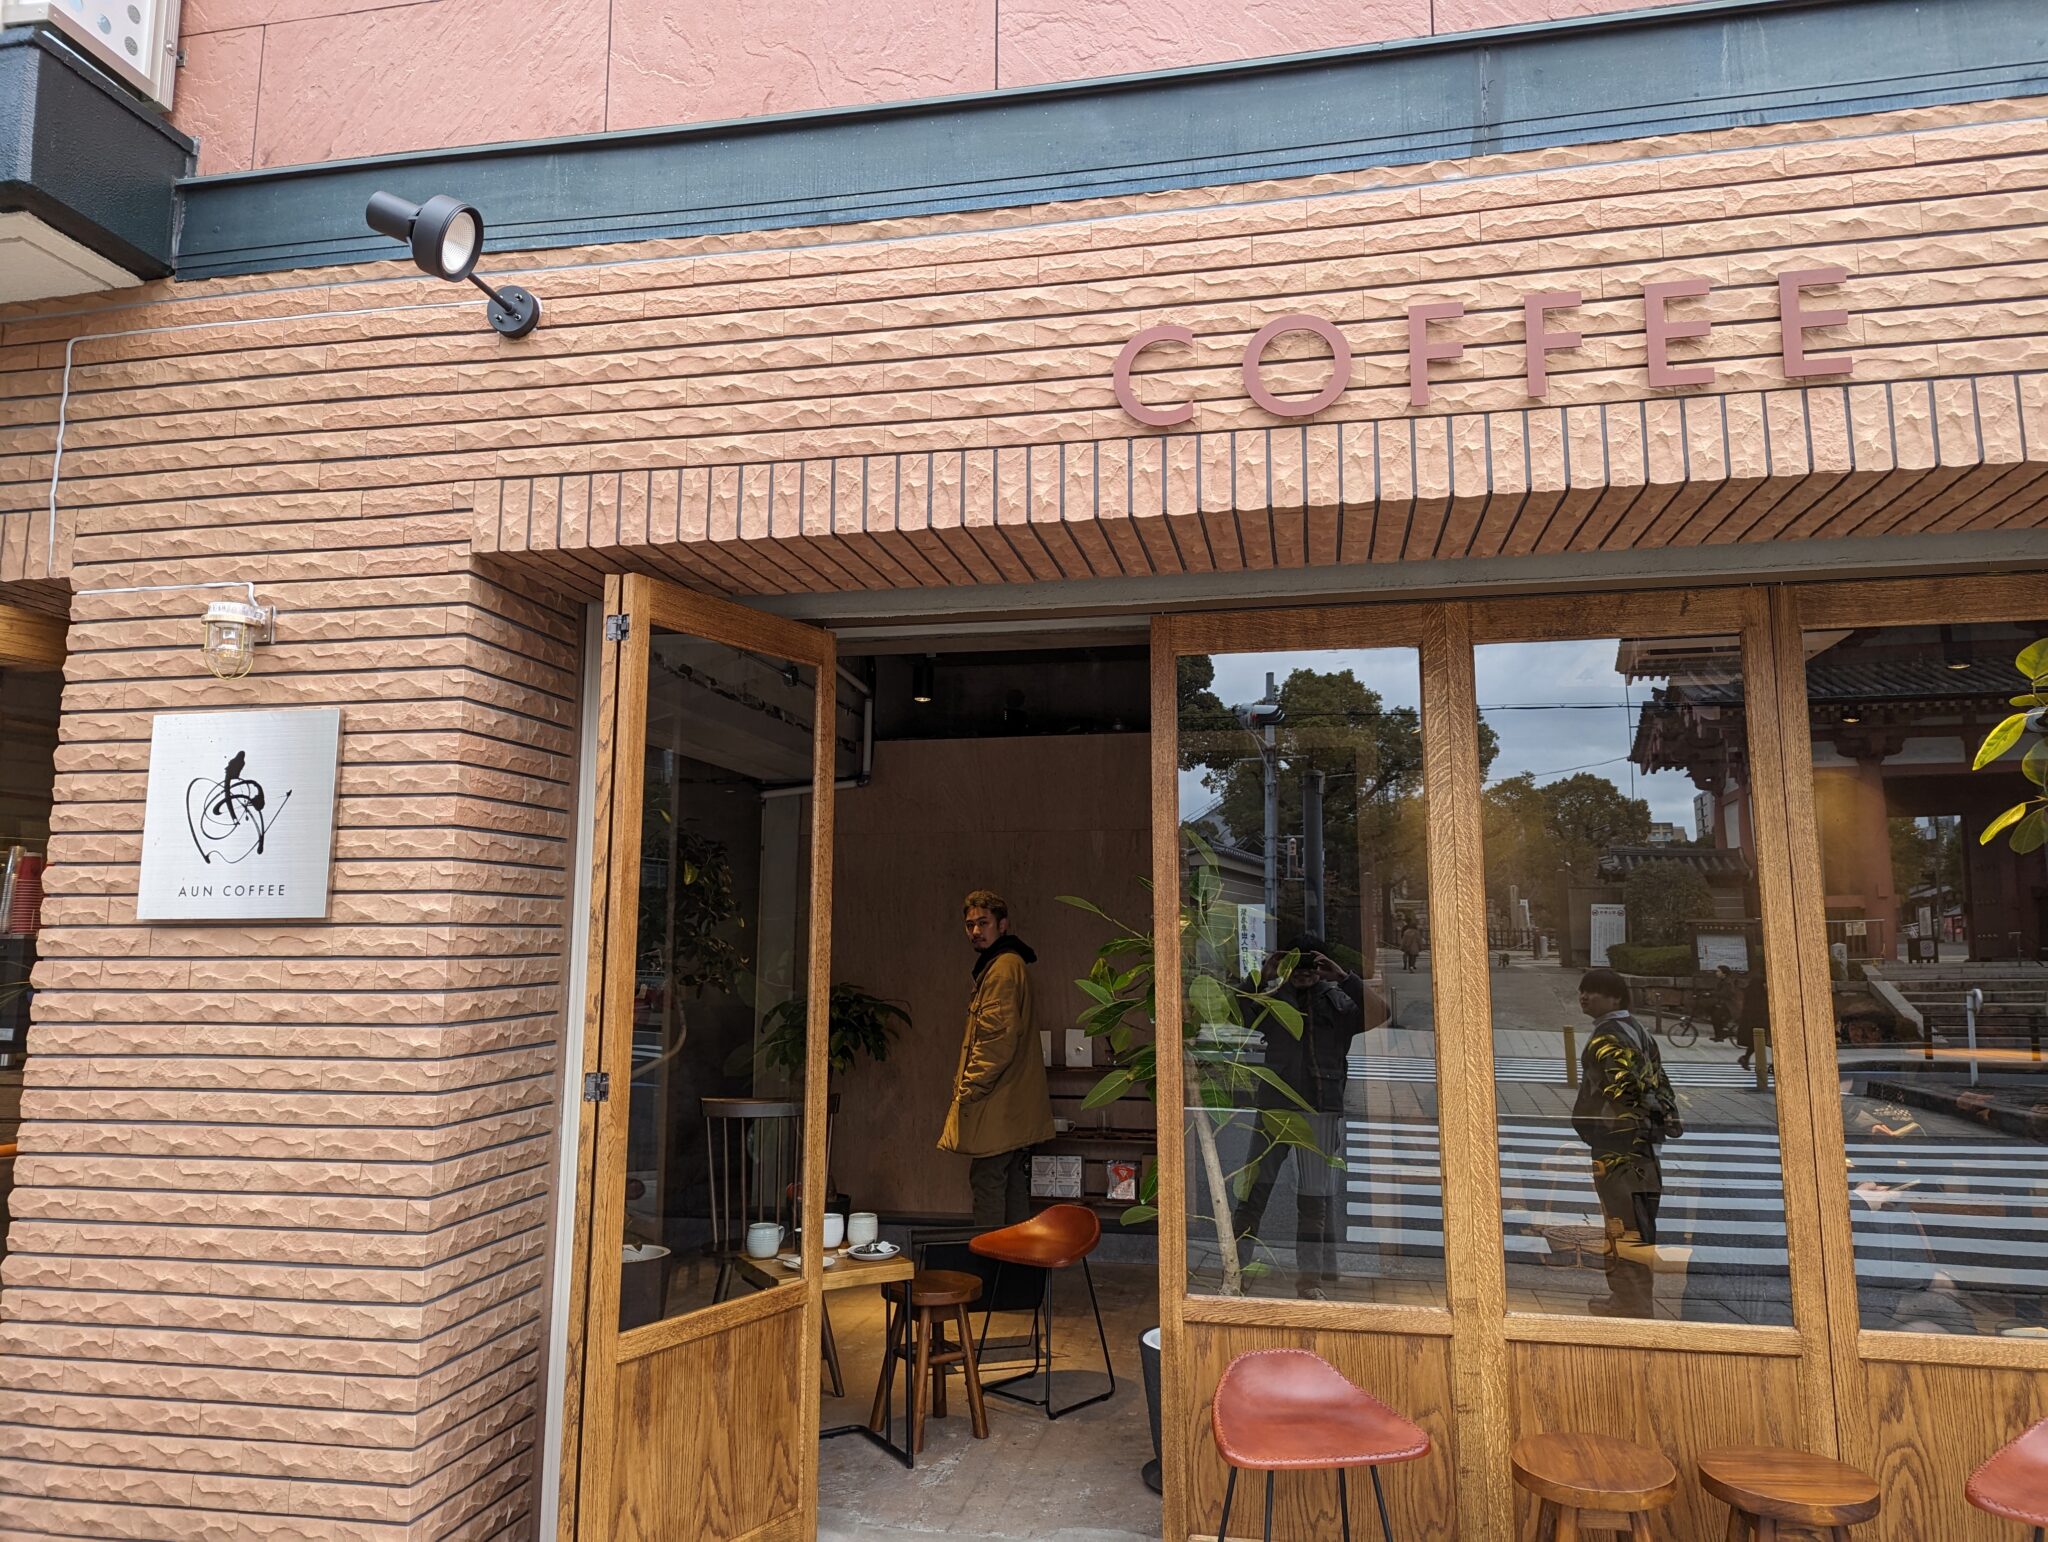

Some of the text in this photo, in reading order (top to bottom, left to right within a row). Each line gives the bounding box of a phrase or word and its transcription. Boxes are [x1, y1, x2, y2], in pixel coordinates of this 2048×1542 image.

[1113, 267, 1854, 426] COFFEE
[178, 884, 286, 898] AUN COFFEE
